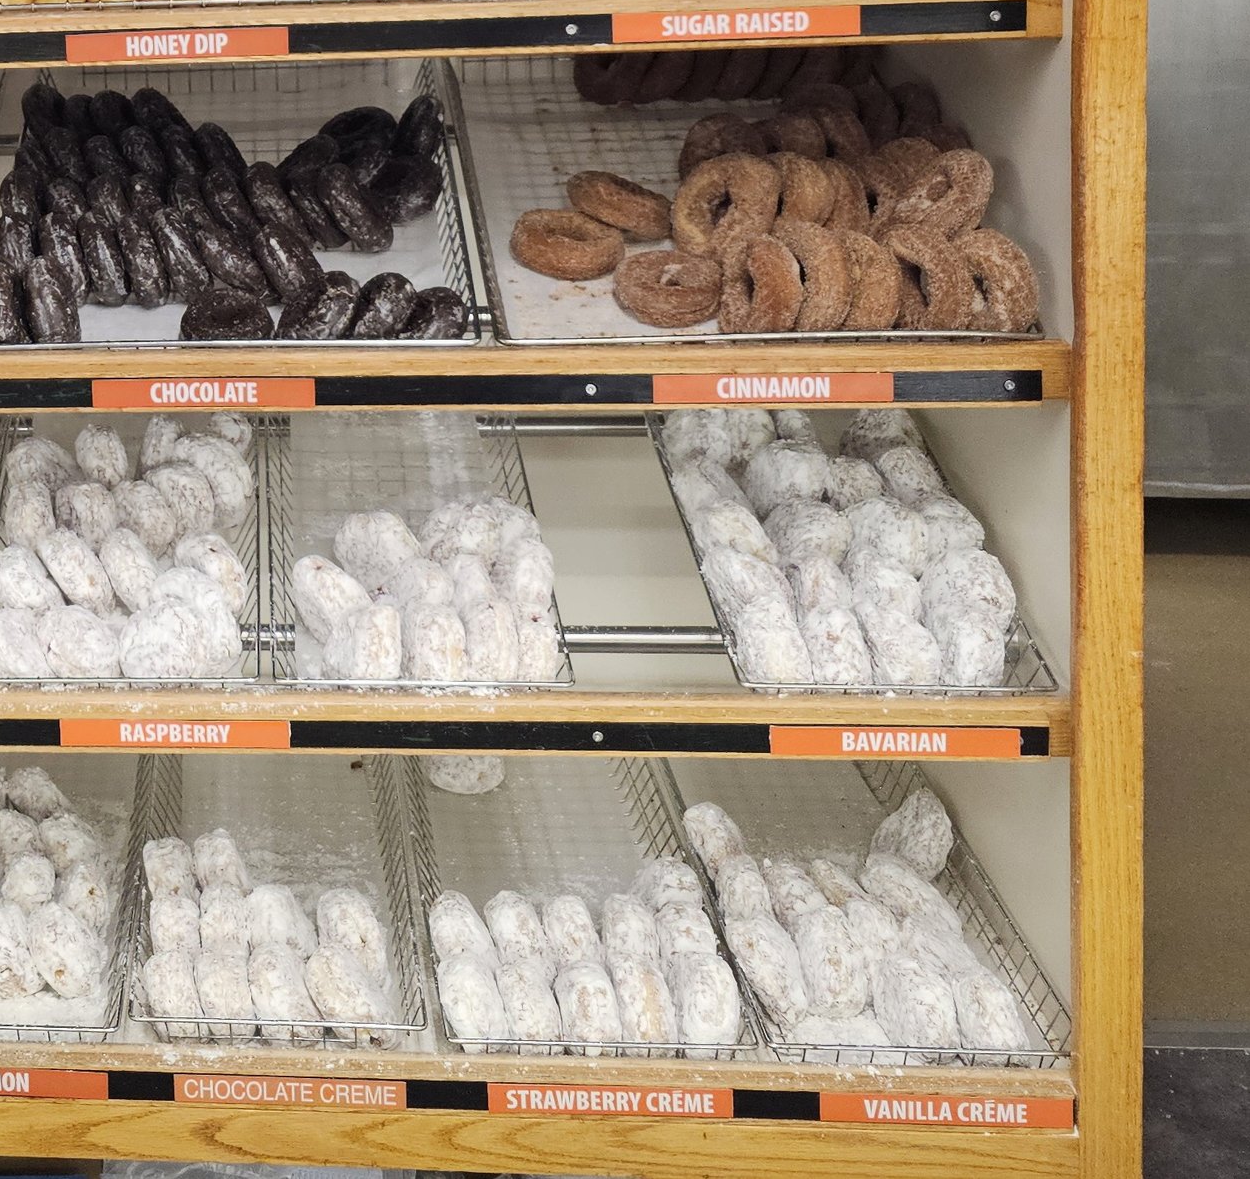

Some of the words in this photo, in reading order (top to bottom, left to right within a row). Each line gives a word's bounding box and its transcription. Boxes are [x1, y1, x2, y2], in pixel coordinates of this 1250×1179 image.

[661, 13, 731, 37] SUGAR
[735, 11, 810, 34] RAISED
[126, 34, 190, 57] HONEY
[195, 33, 229, 54] DIP
[149, 381, 258, 404] CHOCOLATE
[716, 376, 830, 399] CINNAMON
[119, 722, 231, 743] RASPBERRY
[842, 731, 947, 753] BAVARIAN
[184, 1079, 313, 1102] CHOCOLATE
[320, 1083, 397, 1106] CREME
[506, 1089, 642, 1112] STRAWBERRY
[863, 1099, 953, 1121] VANILLA
